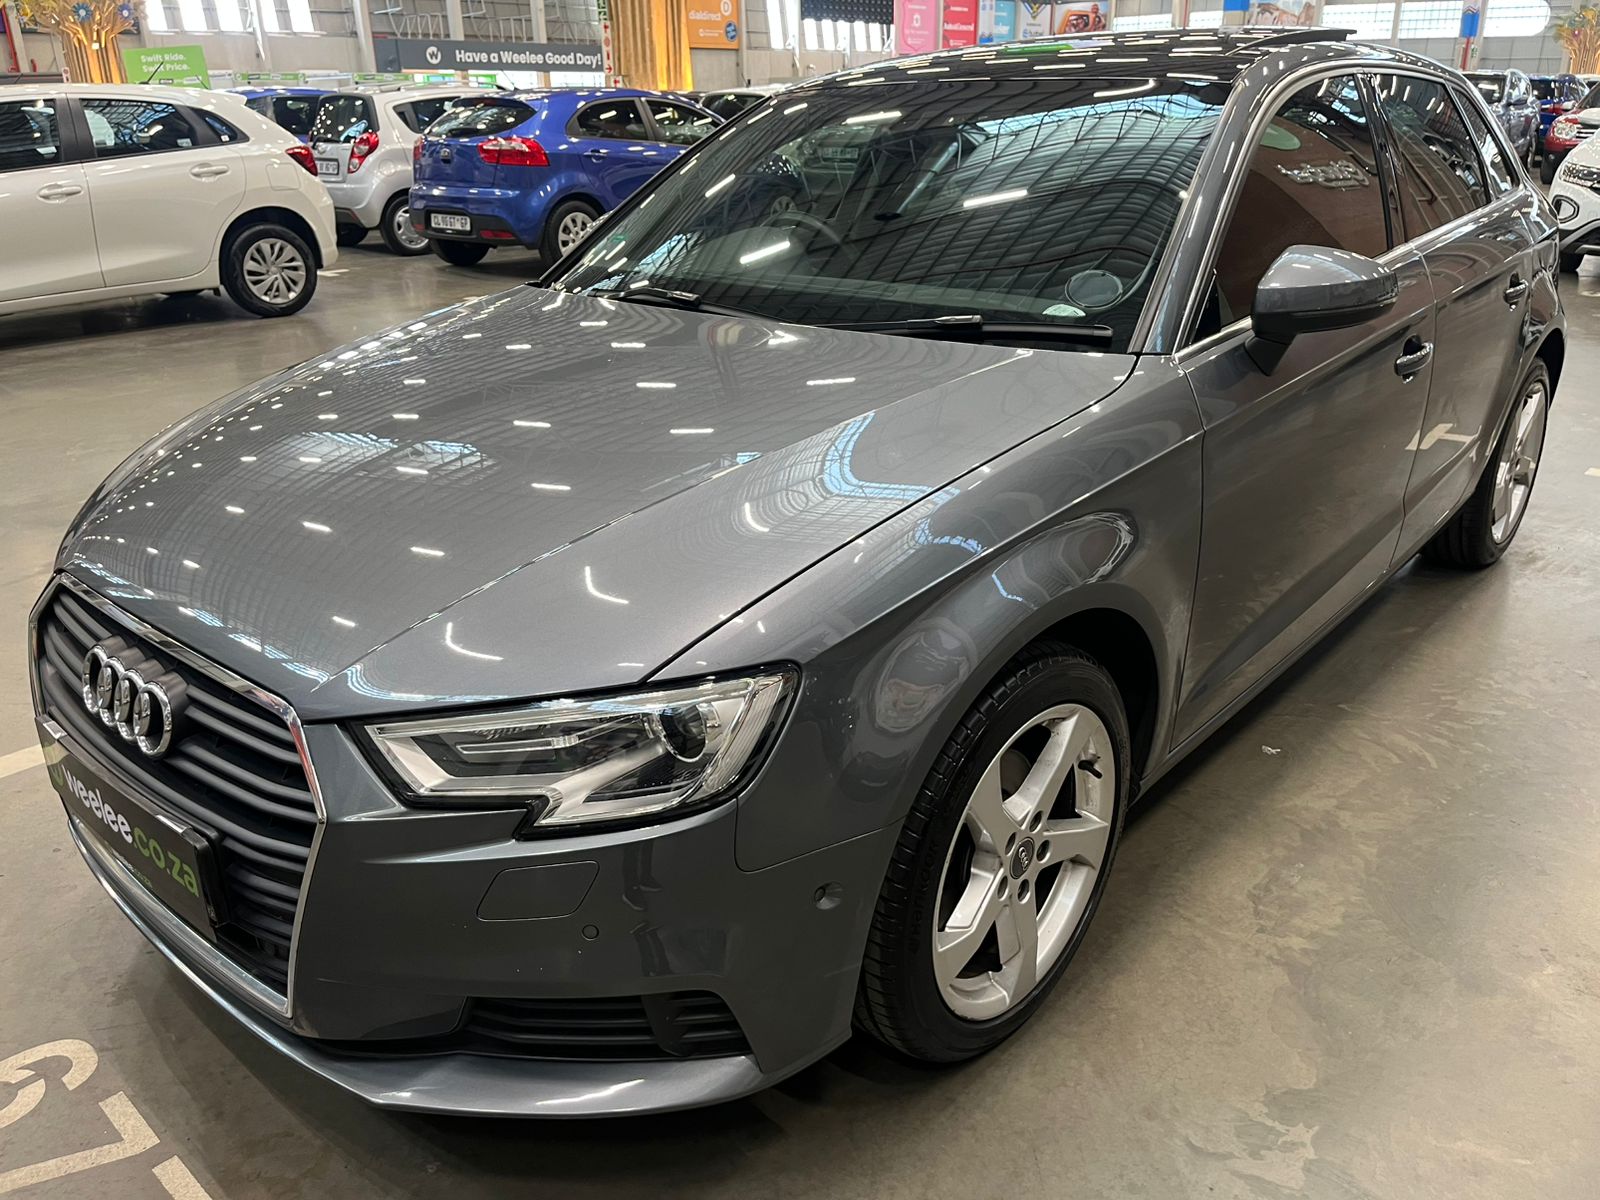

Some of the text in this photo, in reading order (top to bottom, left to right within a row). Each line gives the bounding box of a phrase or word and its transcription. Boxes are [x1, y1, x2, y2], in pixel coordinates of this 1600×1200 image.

[141, 53, 186, 62] Swift Ride.
[455, 49, 602, 68] Have a Weelee Good Day!
[166, 62, 190, 71] Price.
[61, 764, 200, 898] weelee.co.za
